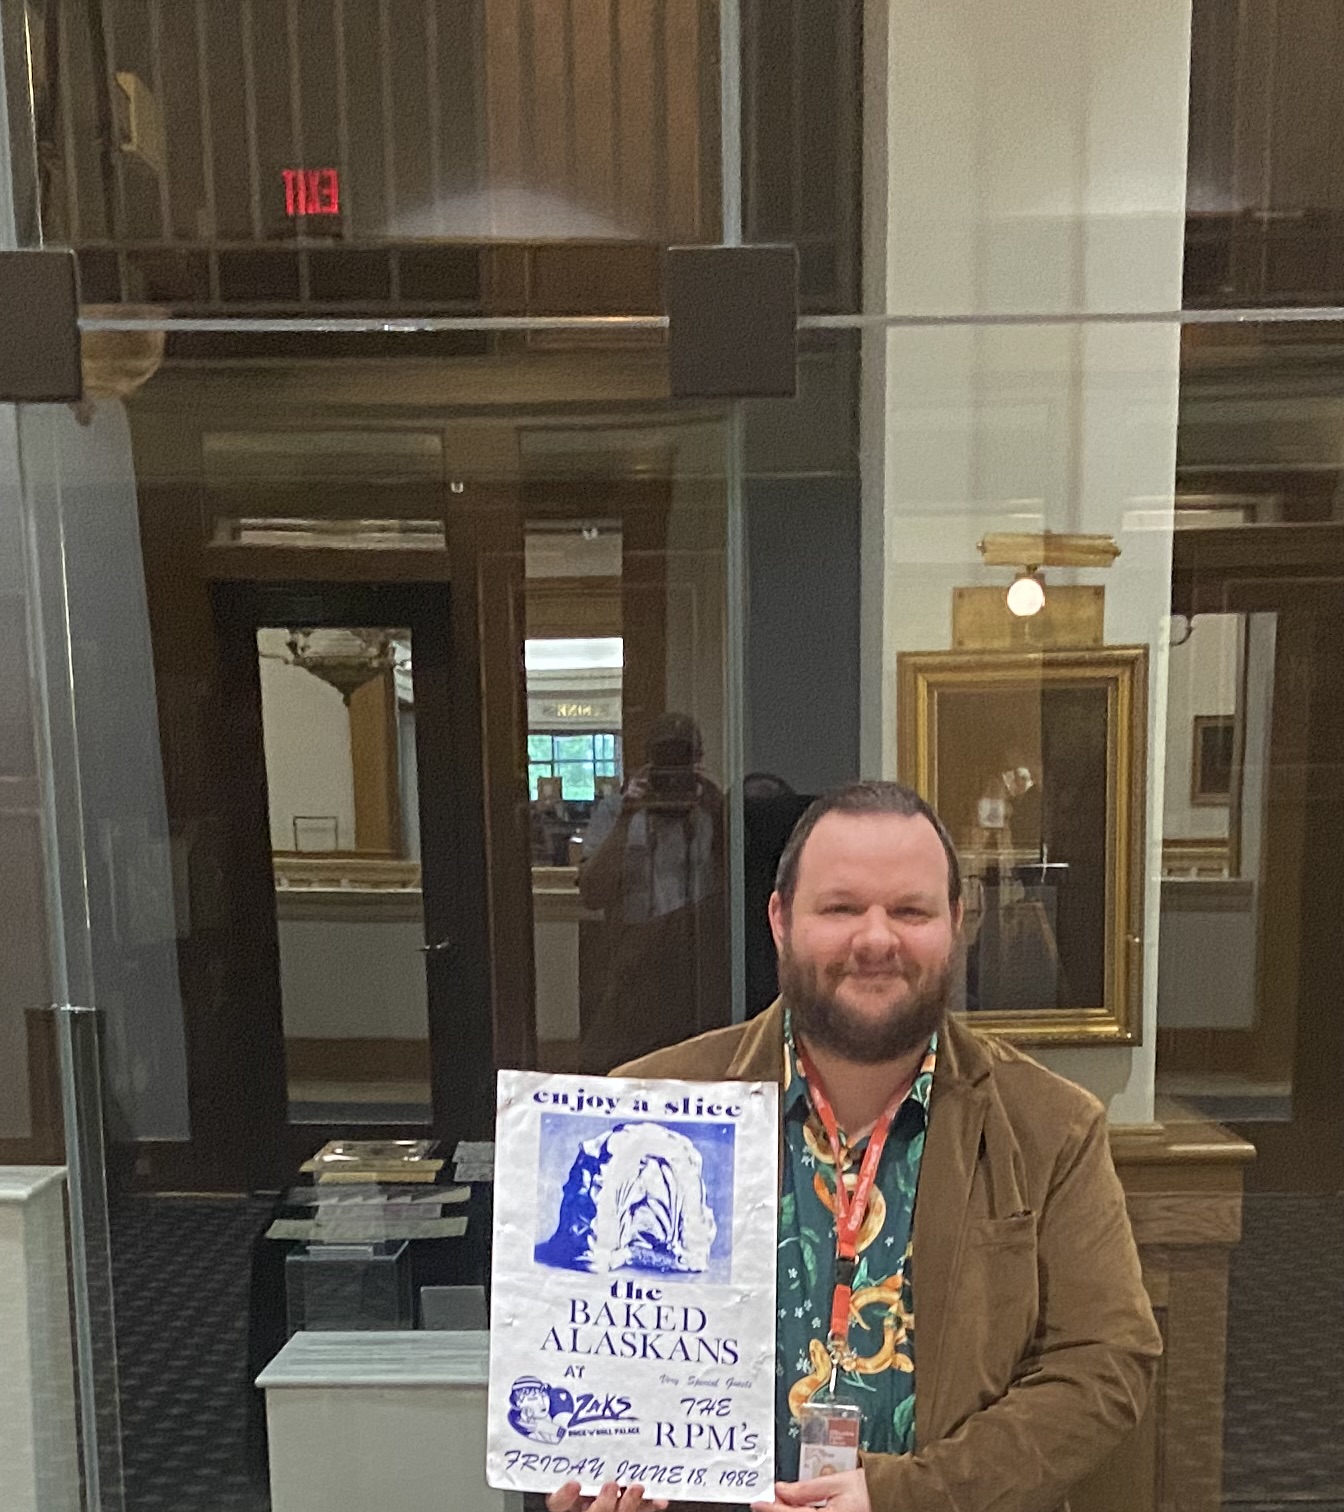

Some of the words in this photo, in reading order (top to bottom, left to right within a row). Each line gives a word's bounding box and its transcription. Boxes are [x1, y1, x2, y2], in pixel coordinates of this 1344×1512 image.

[533, 1088, 618, 1114] enjoy
[633, 1095, 649, 1112] a
[665, 1097, 742, 1117] slice
[610, 1281, 662, 1301] the
[569, 1300, 707, 1333] BAKED
[540, 1327, 739, 1365] ALASKANS
[564, 1365, 585, 1379] AT
[681, 1397, 731, 1417] THE
[504, 1451, 604, 1480] FRIDAY
[616, 1458, 684, 1483] JUNE
[687, 1468, 707, 1487] 18,
[719, 1470, 759, 1487] 1982
